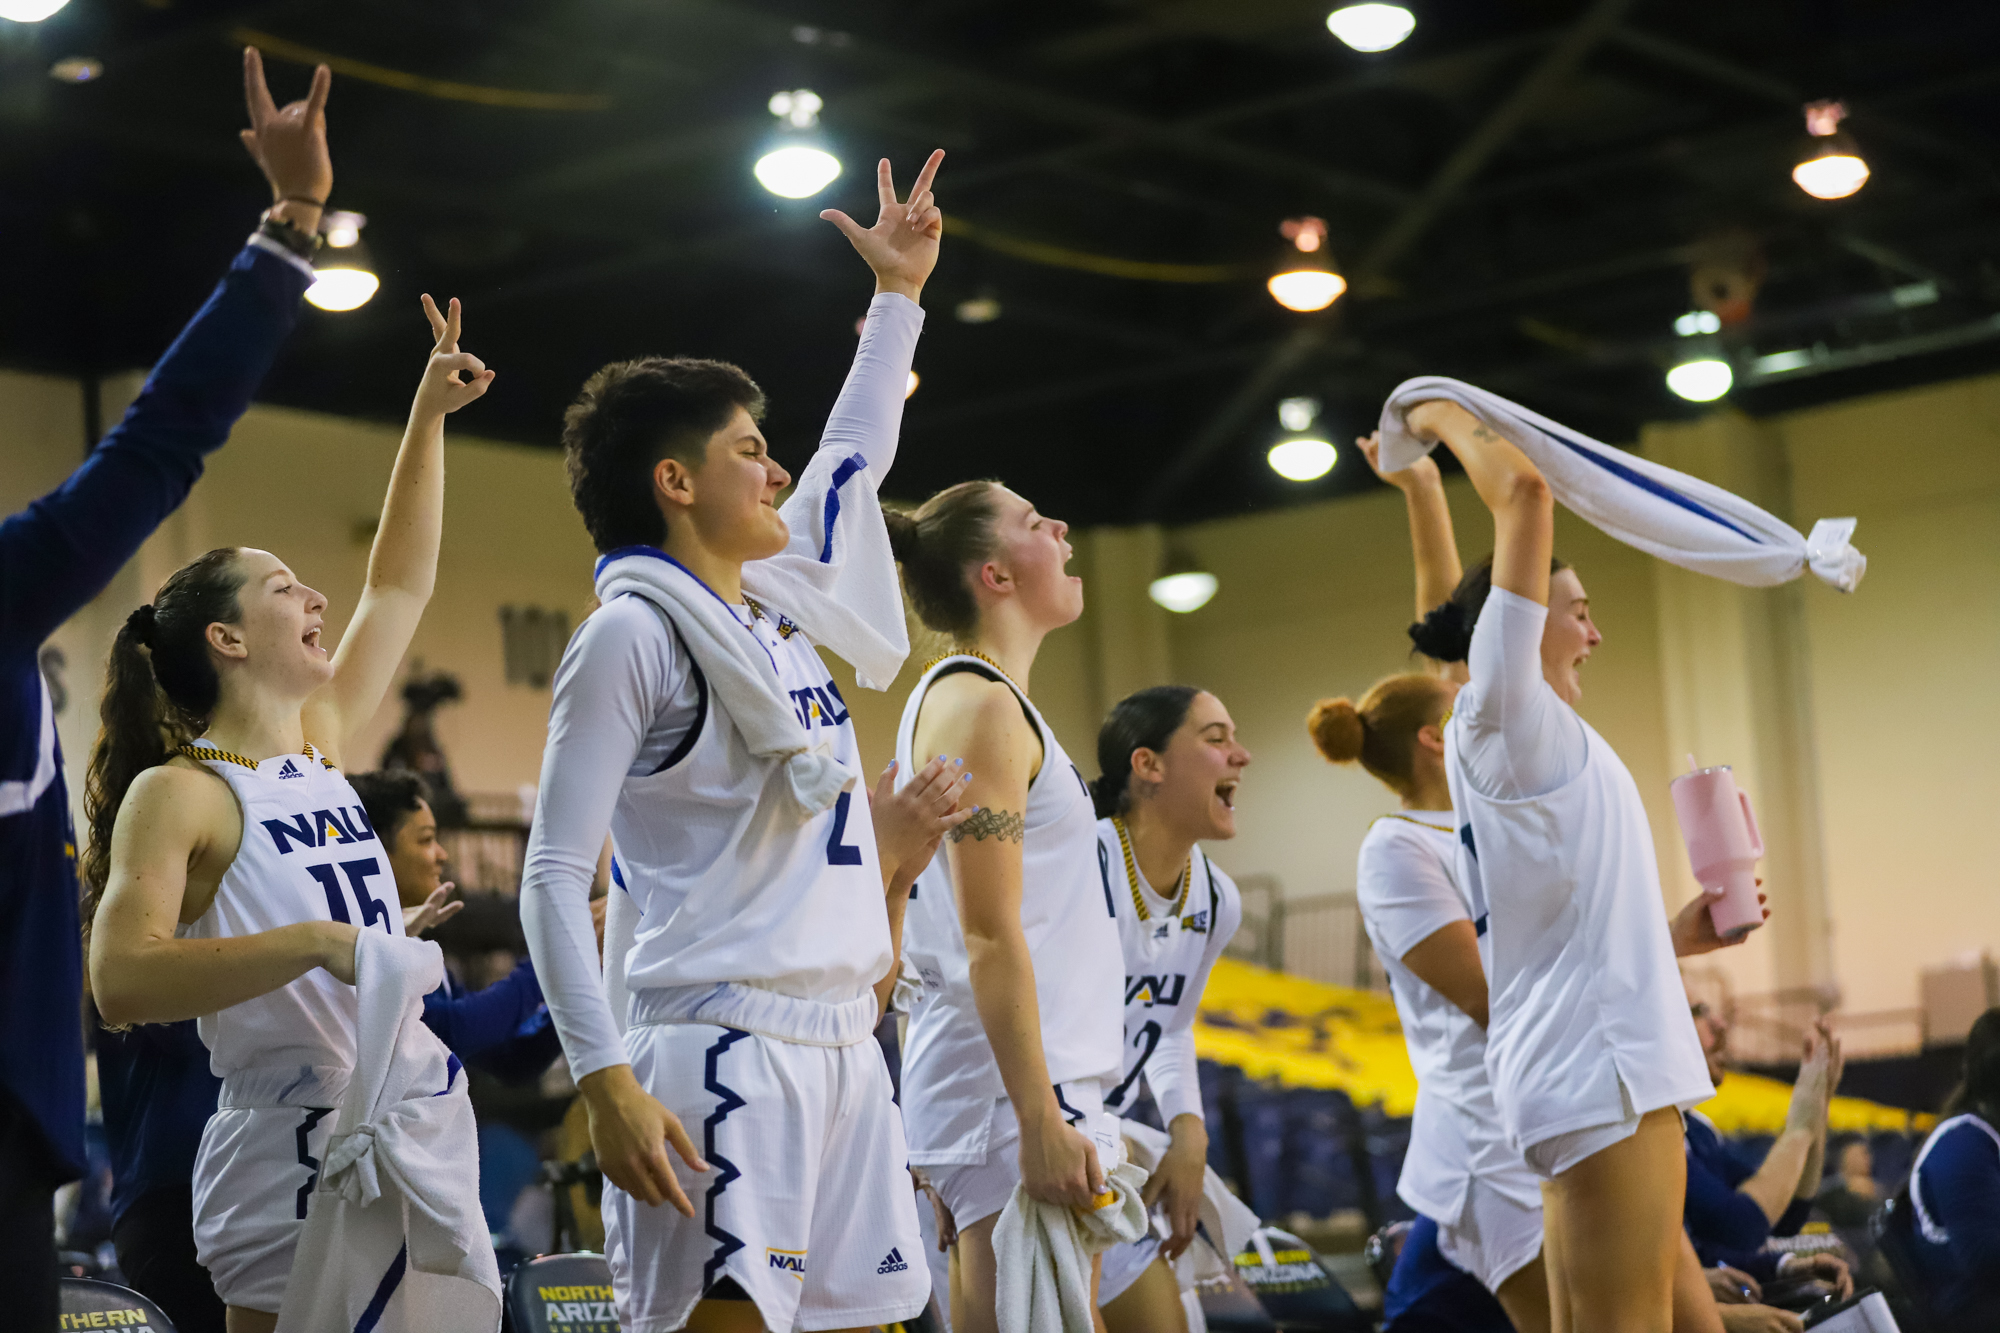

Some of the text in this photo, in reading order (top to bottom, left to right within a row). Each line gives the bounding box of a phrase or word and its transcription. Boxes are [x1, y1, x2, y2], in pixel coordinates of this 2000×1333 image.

[260, 805, 376, 855] NAU
[305, 857, 392, 935] 15
[1125, 973, 1186, 1008] AU
[1103, 1019, 1162, 1107] 2
[877, 1261, 908, 1275] adidas
[538, 1285, 615, 1301] NORTH
[59, 1308, 148, 1329] THERN
